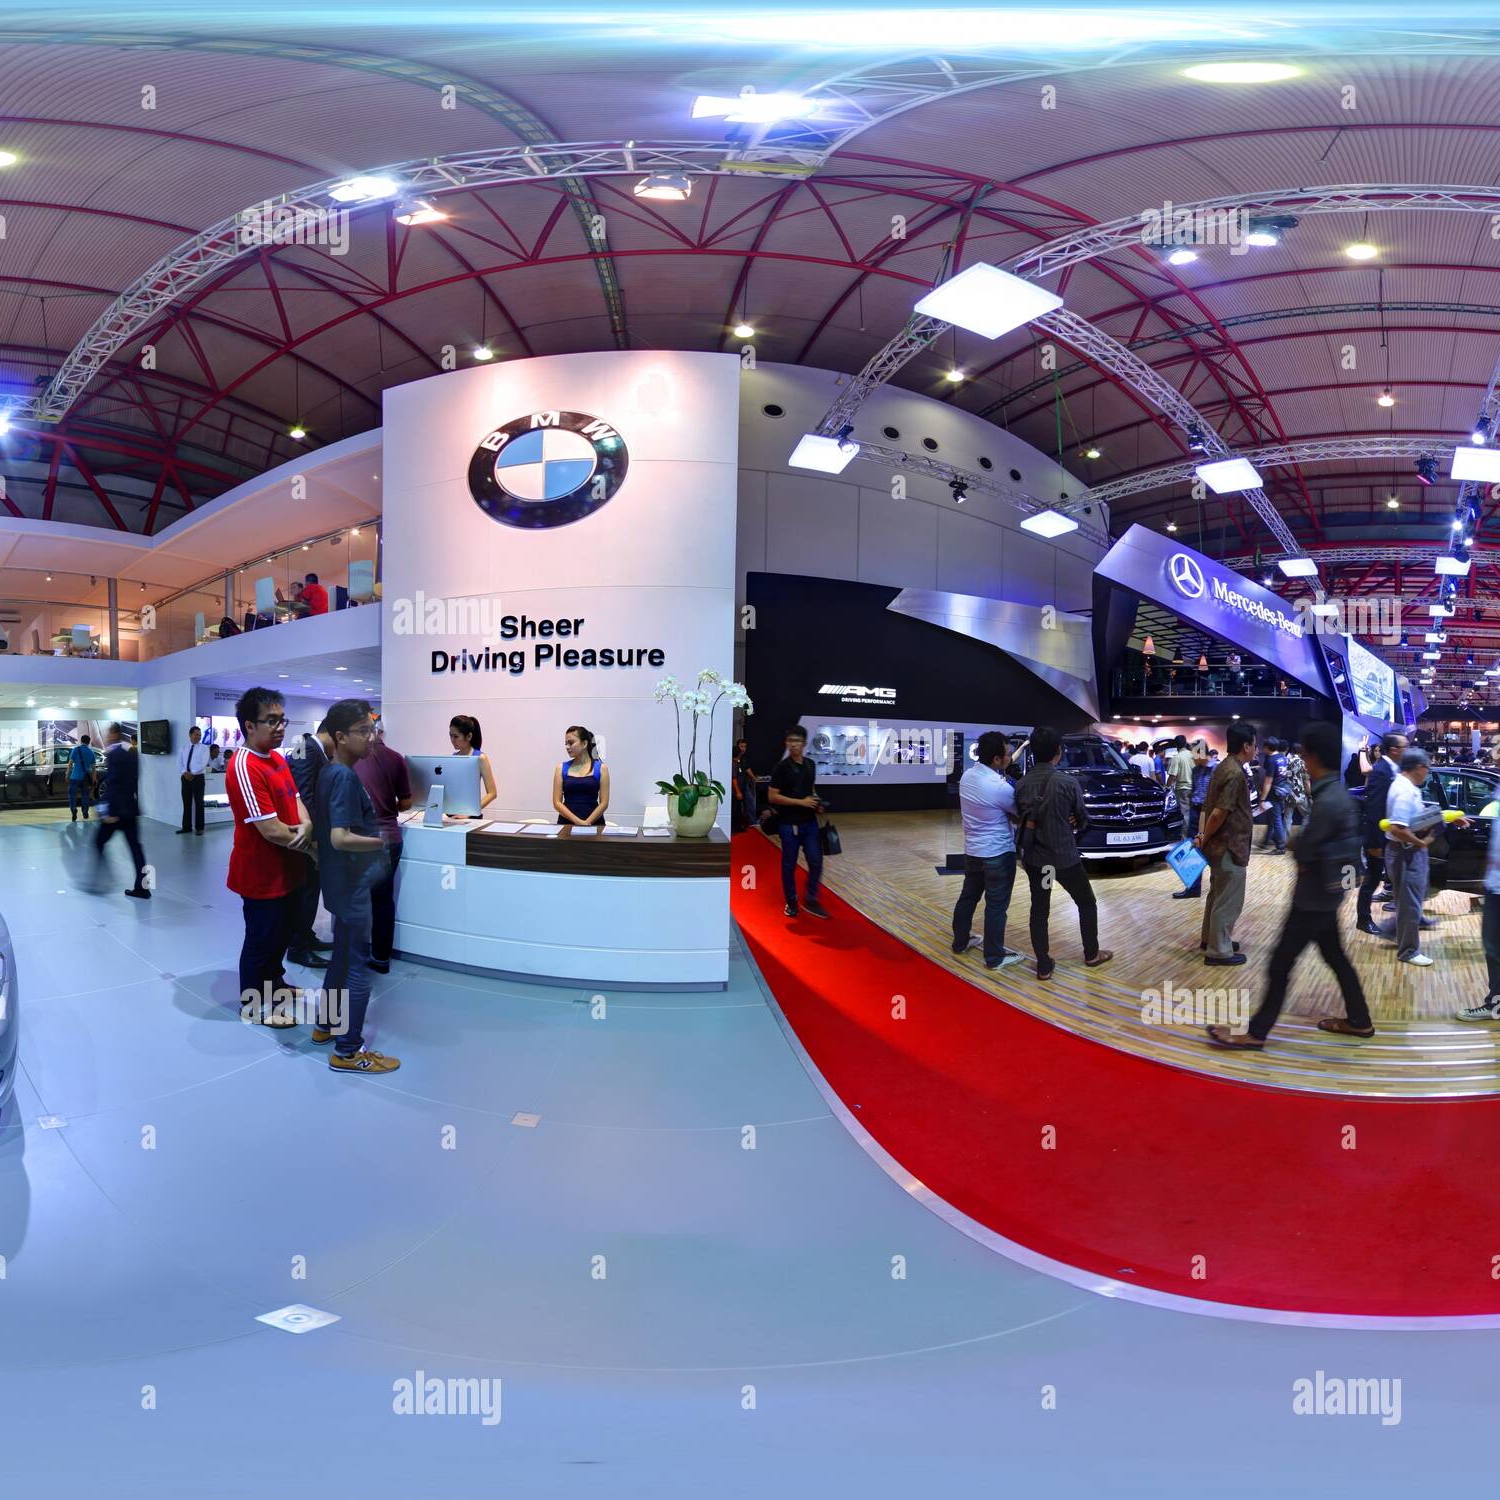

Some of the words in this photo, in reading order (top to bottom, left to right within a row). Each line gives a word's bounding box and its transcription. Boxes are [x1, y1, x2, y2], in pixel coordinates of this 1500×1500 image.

[480, 411, 617, 452] BMW
[1213, 577, 1302, 638] Mercedes-Benz
[500, 615, 584, 639] Sheer
[432, 647, 525, 674] Driving
[535, 643, 665, 668] Pleasure
[844, 685, 897, 698] AMG
